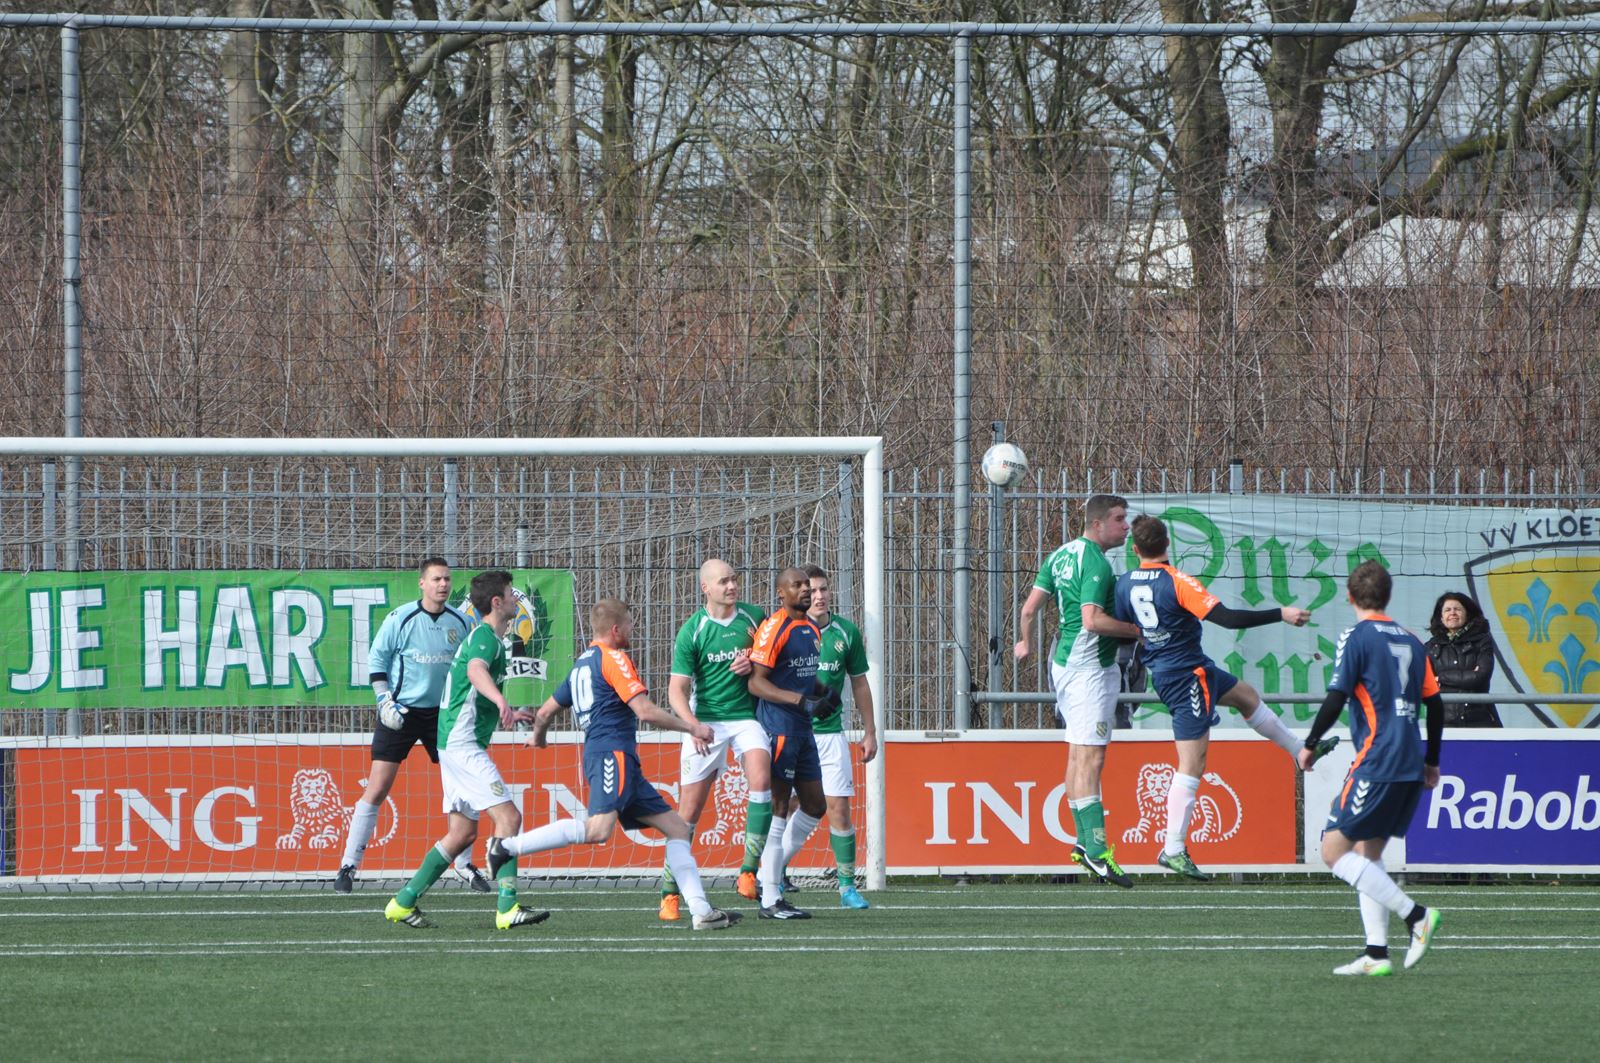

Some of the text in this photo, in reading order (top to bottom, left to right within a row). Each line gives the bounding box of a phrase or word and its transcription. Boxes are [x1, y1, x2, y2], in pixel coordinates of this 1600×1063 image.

[1526, 515, 1600, 540] KLOE
[1130, 585, 1159, 629] 6
[10, 586, 386, 691] JE HART
[570, 665, 594, 713] 10
[1387, 642, 1413, 694] 7
[71, 785, 262, 853] ING
[1426, 774, 1600, 831] Rabob
